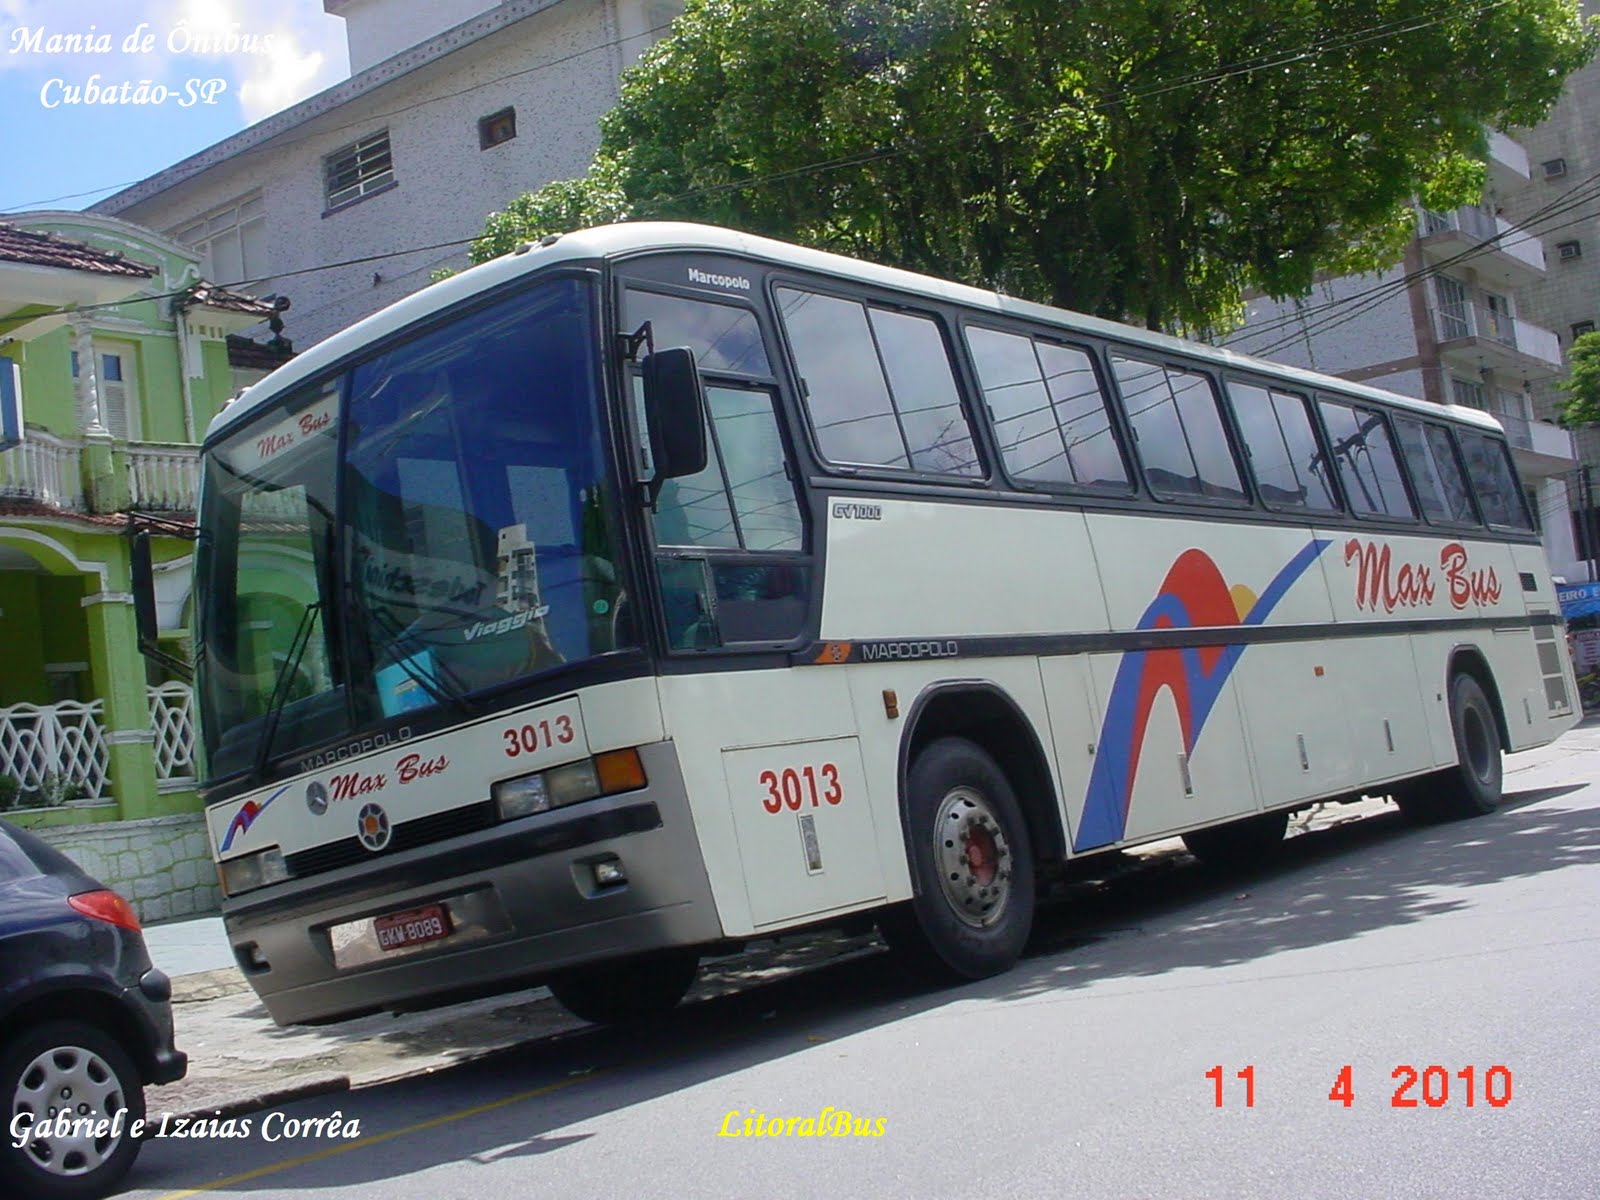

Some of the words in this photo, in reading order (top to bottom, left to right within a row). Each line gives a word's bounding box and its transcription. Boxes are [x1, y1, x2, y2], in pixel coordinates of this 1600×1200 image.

[688, 267, 750, 290] Marcopolo
[257, 431, 294, 459] Max
[298, 411, 332, 435] Bus
[1344, 538, 1436, 614] Max
[1440, 542, 1502, 610] Bus
[463, 605, 550, 641] Viaggio
[862, 640, 958, 660] MARCOPOLO
[300, 726, 412, 772] MARCOPOLO
[503, 715, 574, 758] 3013
[329, 772, 387, 801] Max
[396, 753, 450, 784] Bus
[759, 763, 843, 814] 3013
